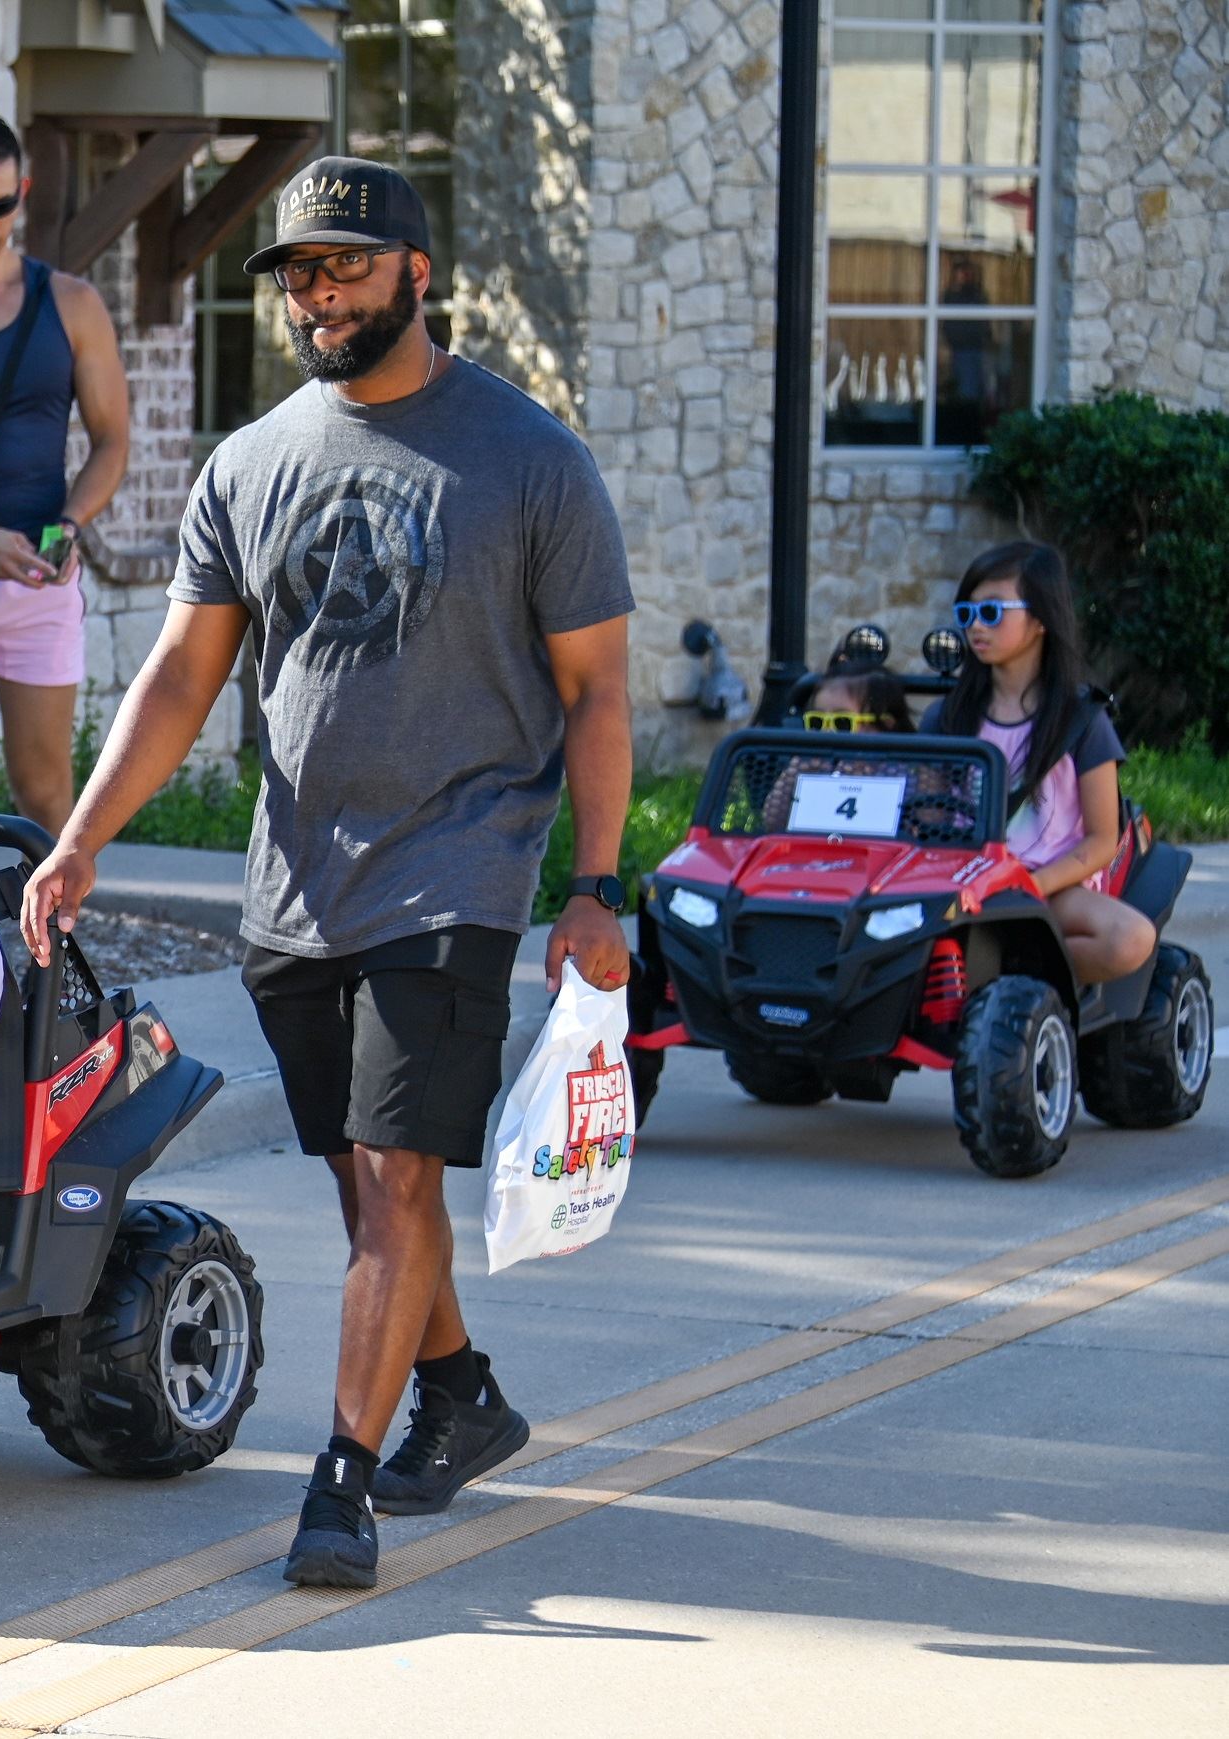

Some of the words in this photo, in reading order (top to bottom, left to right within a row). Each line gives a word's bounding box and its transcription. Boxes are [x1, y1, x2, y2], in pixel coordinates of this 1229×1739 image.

[290, 176, 351, 211] ODIN
[836, 797, 857, 820] 4
[571, 1069, 624, 1103] FRISCO
[570, 1095, 625, 1142] FIRE
[532, 1139, 597, 1181] Safety
[569, 1201, 590, 1215] Texas
[592, 1192, 616, 1210] Health
